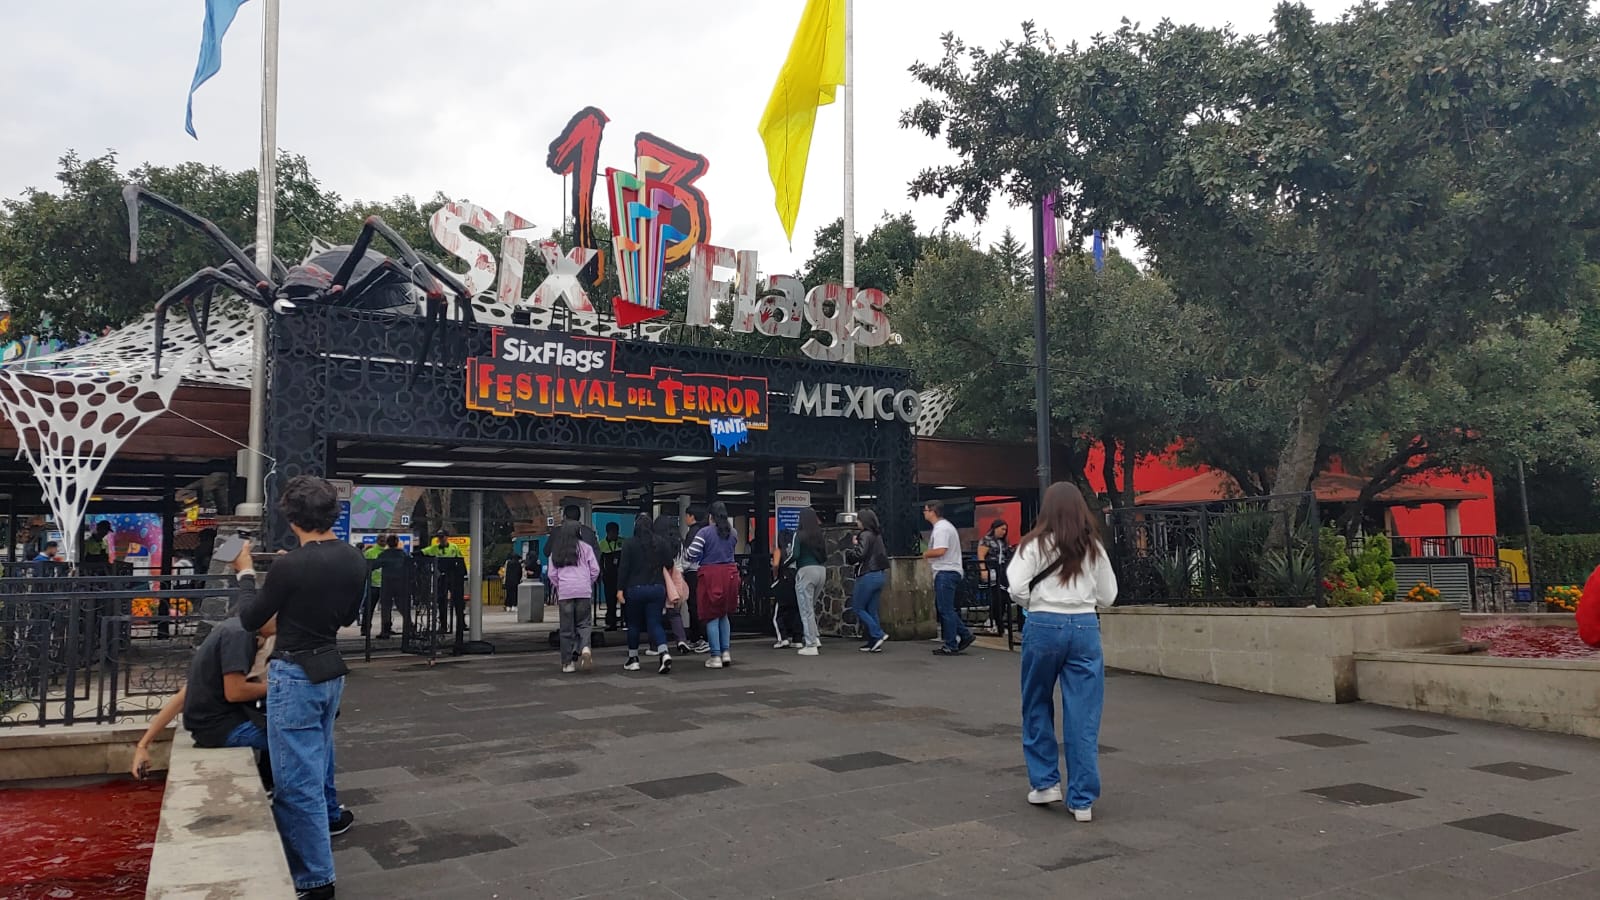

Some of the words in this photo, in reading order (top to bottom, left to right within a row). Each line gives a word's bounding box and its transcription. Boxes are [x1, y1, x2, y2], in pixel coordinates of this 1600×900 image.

[429, 202, 598, 312] Six
[687, 243, 890, 361] Flags
[502, 337, 605, 372] SixFlags
[479, 363, 622, 408] FESTIVAL
[628, 387, 656, 408] DEL
[657, 377, 760, 417] TERROR
[791, 380, 920, 423] MEXICO
[709, 417, 747, 435] FANTA
